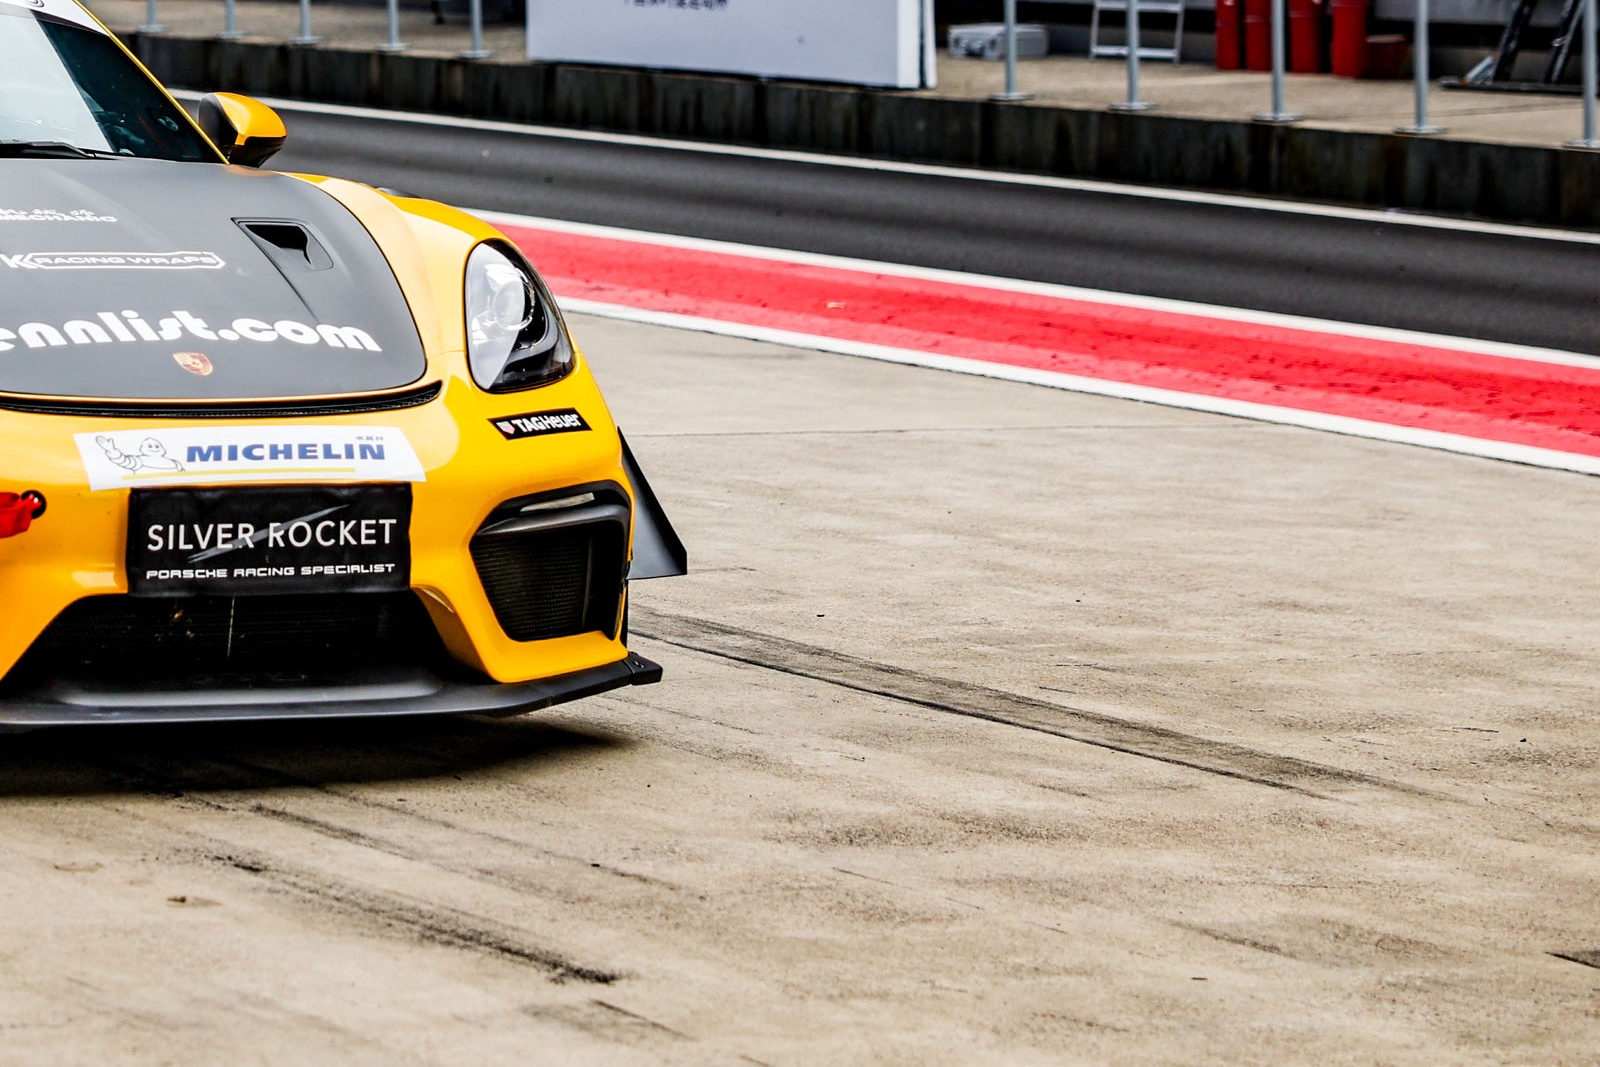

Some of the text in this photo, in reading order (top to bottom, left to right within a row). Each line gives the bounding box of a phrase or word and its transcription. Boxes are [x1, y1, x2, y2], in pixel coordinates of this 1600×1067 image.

[37, 256, 125, 265] RACING
[186, 442, 385, 462] MICHELIN
[147, 519, 397, 551] SILVER ROCKET
[146, 563, 396, 579] PORSCHE RACING SPECIALIST
